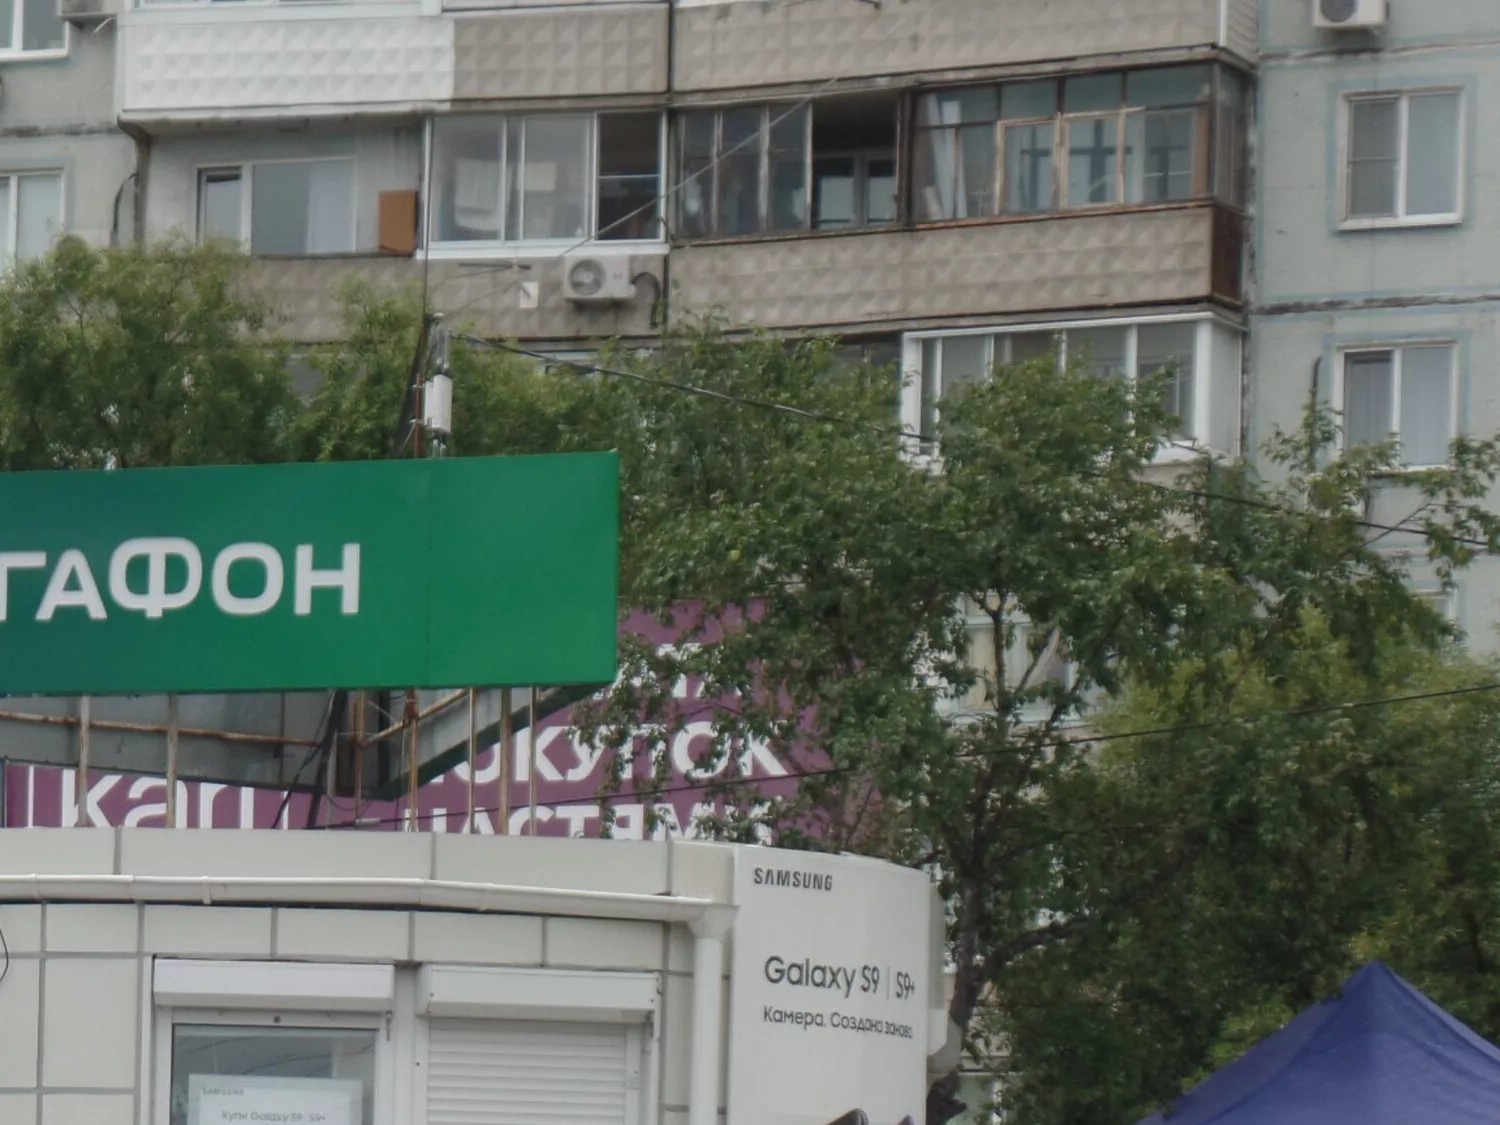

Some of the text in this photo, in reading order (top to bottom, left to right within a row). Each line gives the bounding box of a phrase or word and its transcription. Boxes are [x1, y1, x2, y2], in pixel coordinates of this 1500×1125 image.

[430, 721, 788, 784] ОКУПОК
[753, 867, 834, 892] SAMSUNG
[764, 955, 857, 999] Galaxy
[860, 964, 881, 994] S9
[763, 1005, 828, 1030] Камера.
